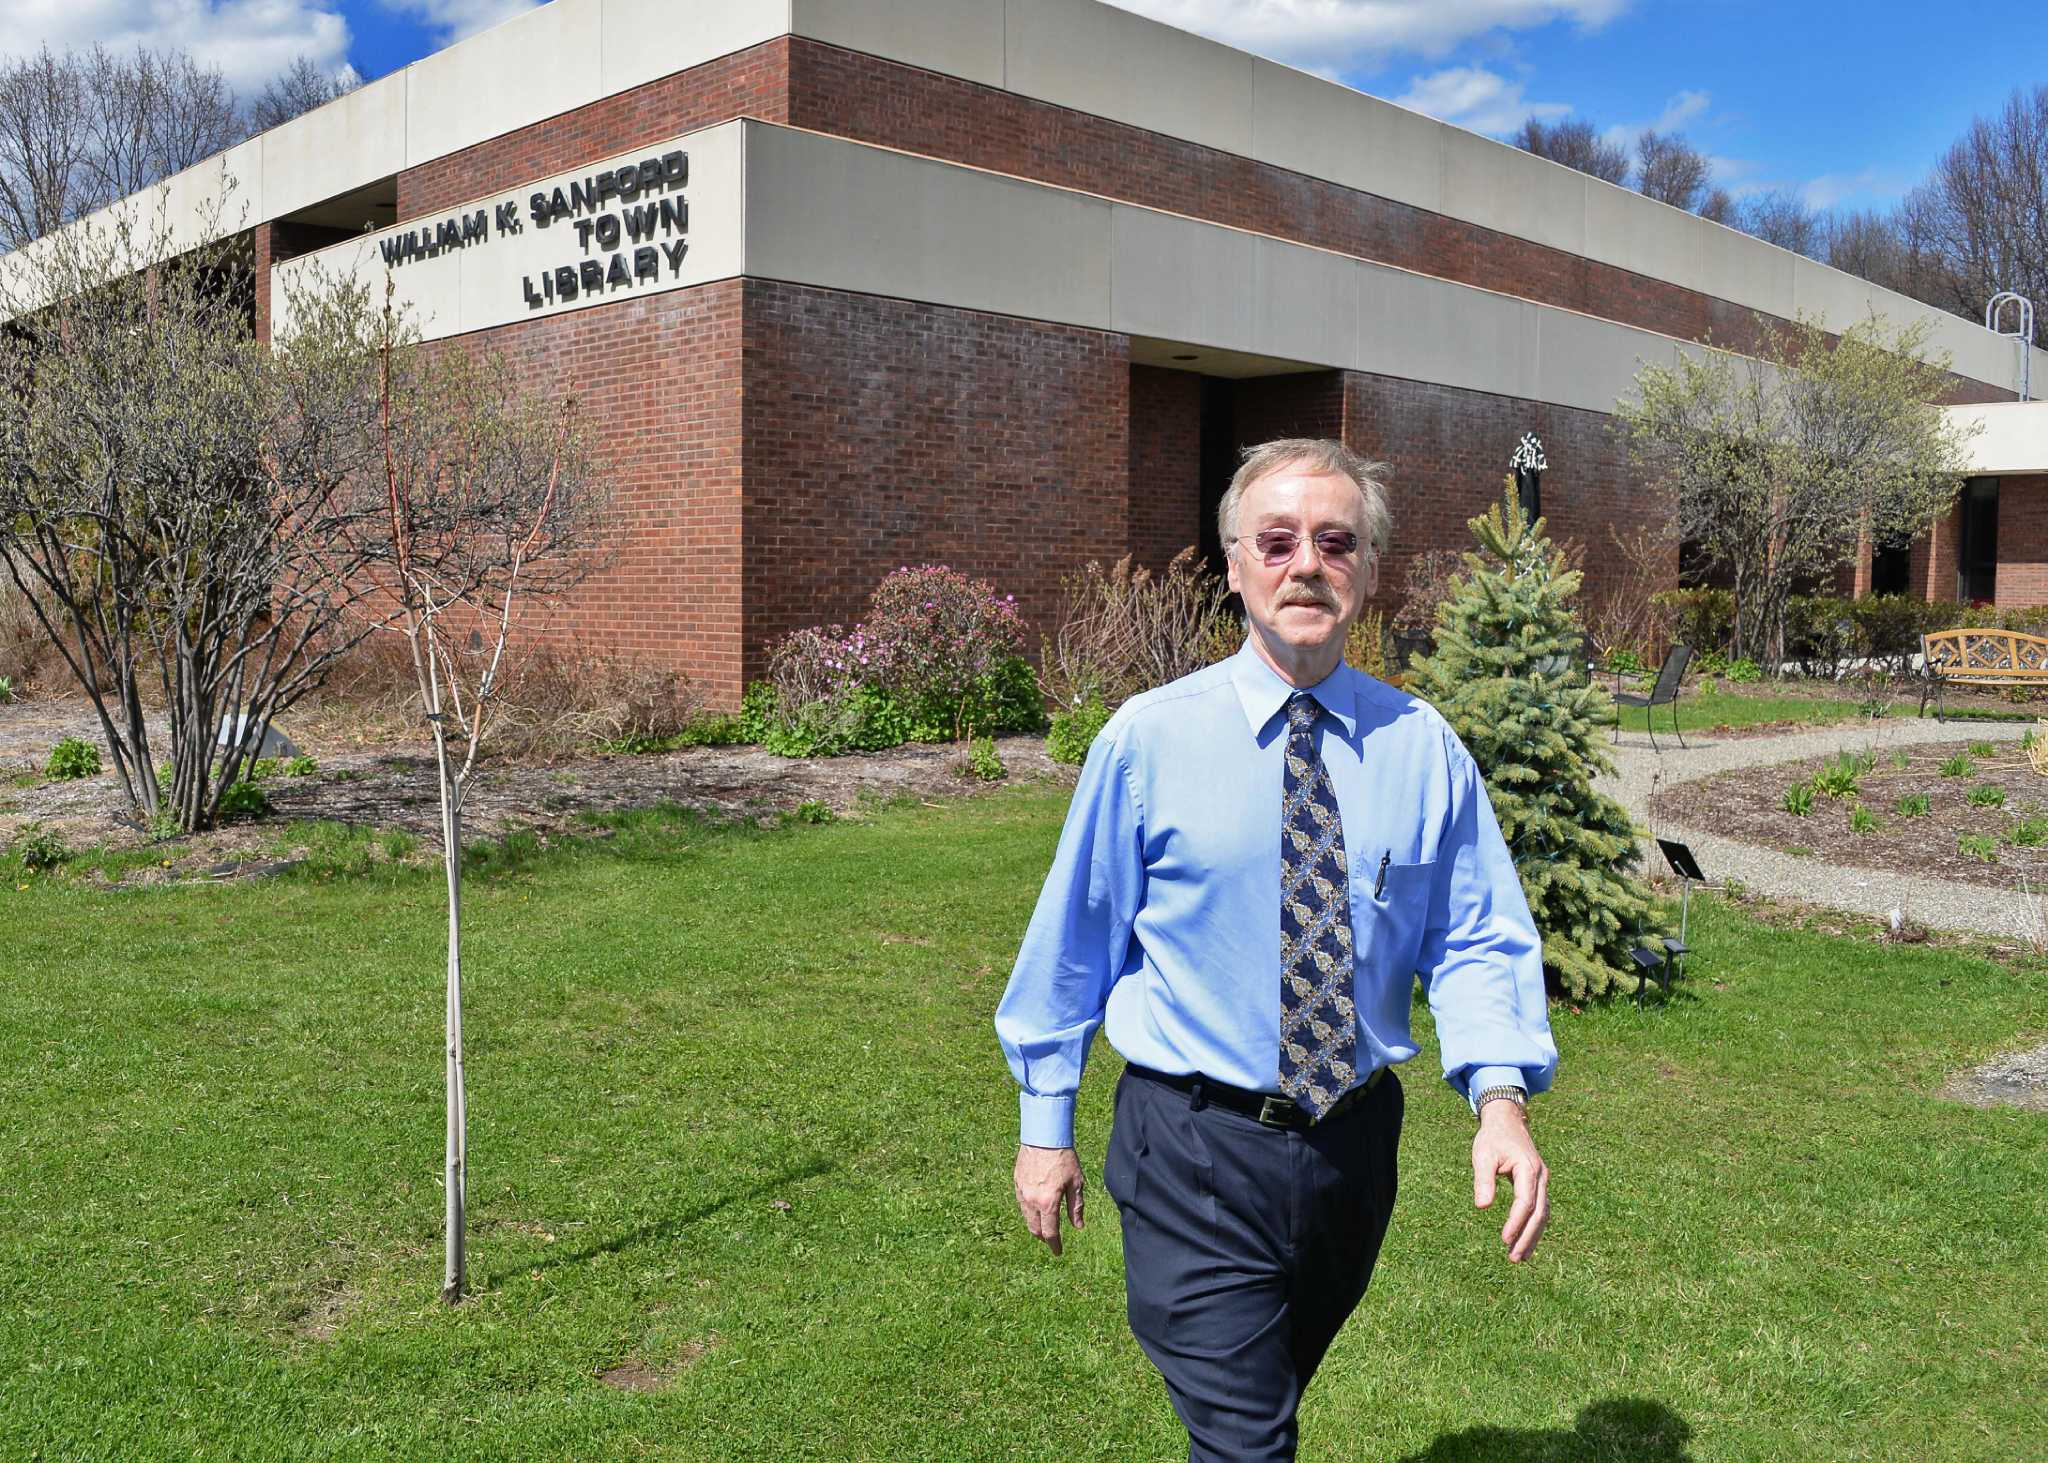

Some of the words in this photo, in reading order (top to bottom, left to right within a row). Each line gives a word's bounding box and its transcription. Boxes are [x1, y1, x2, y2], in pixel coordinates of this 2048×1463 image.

[380, 209, 487, 267] WILLIAM
[496, 200, 523, 236] K.
[530, 150, 688, 228] SANFORD
[574, 195, 688, 252] TOWN
[523, 239, 688, 308] LIBRARY
